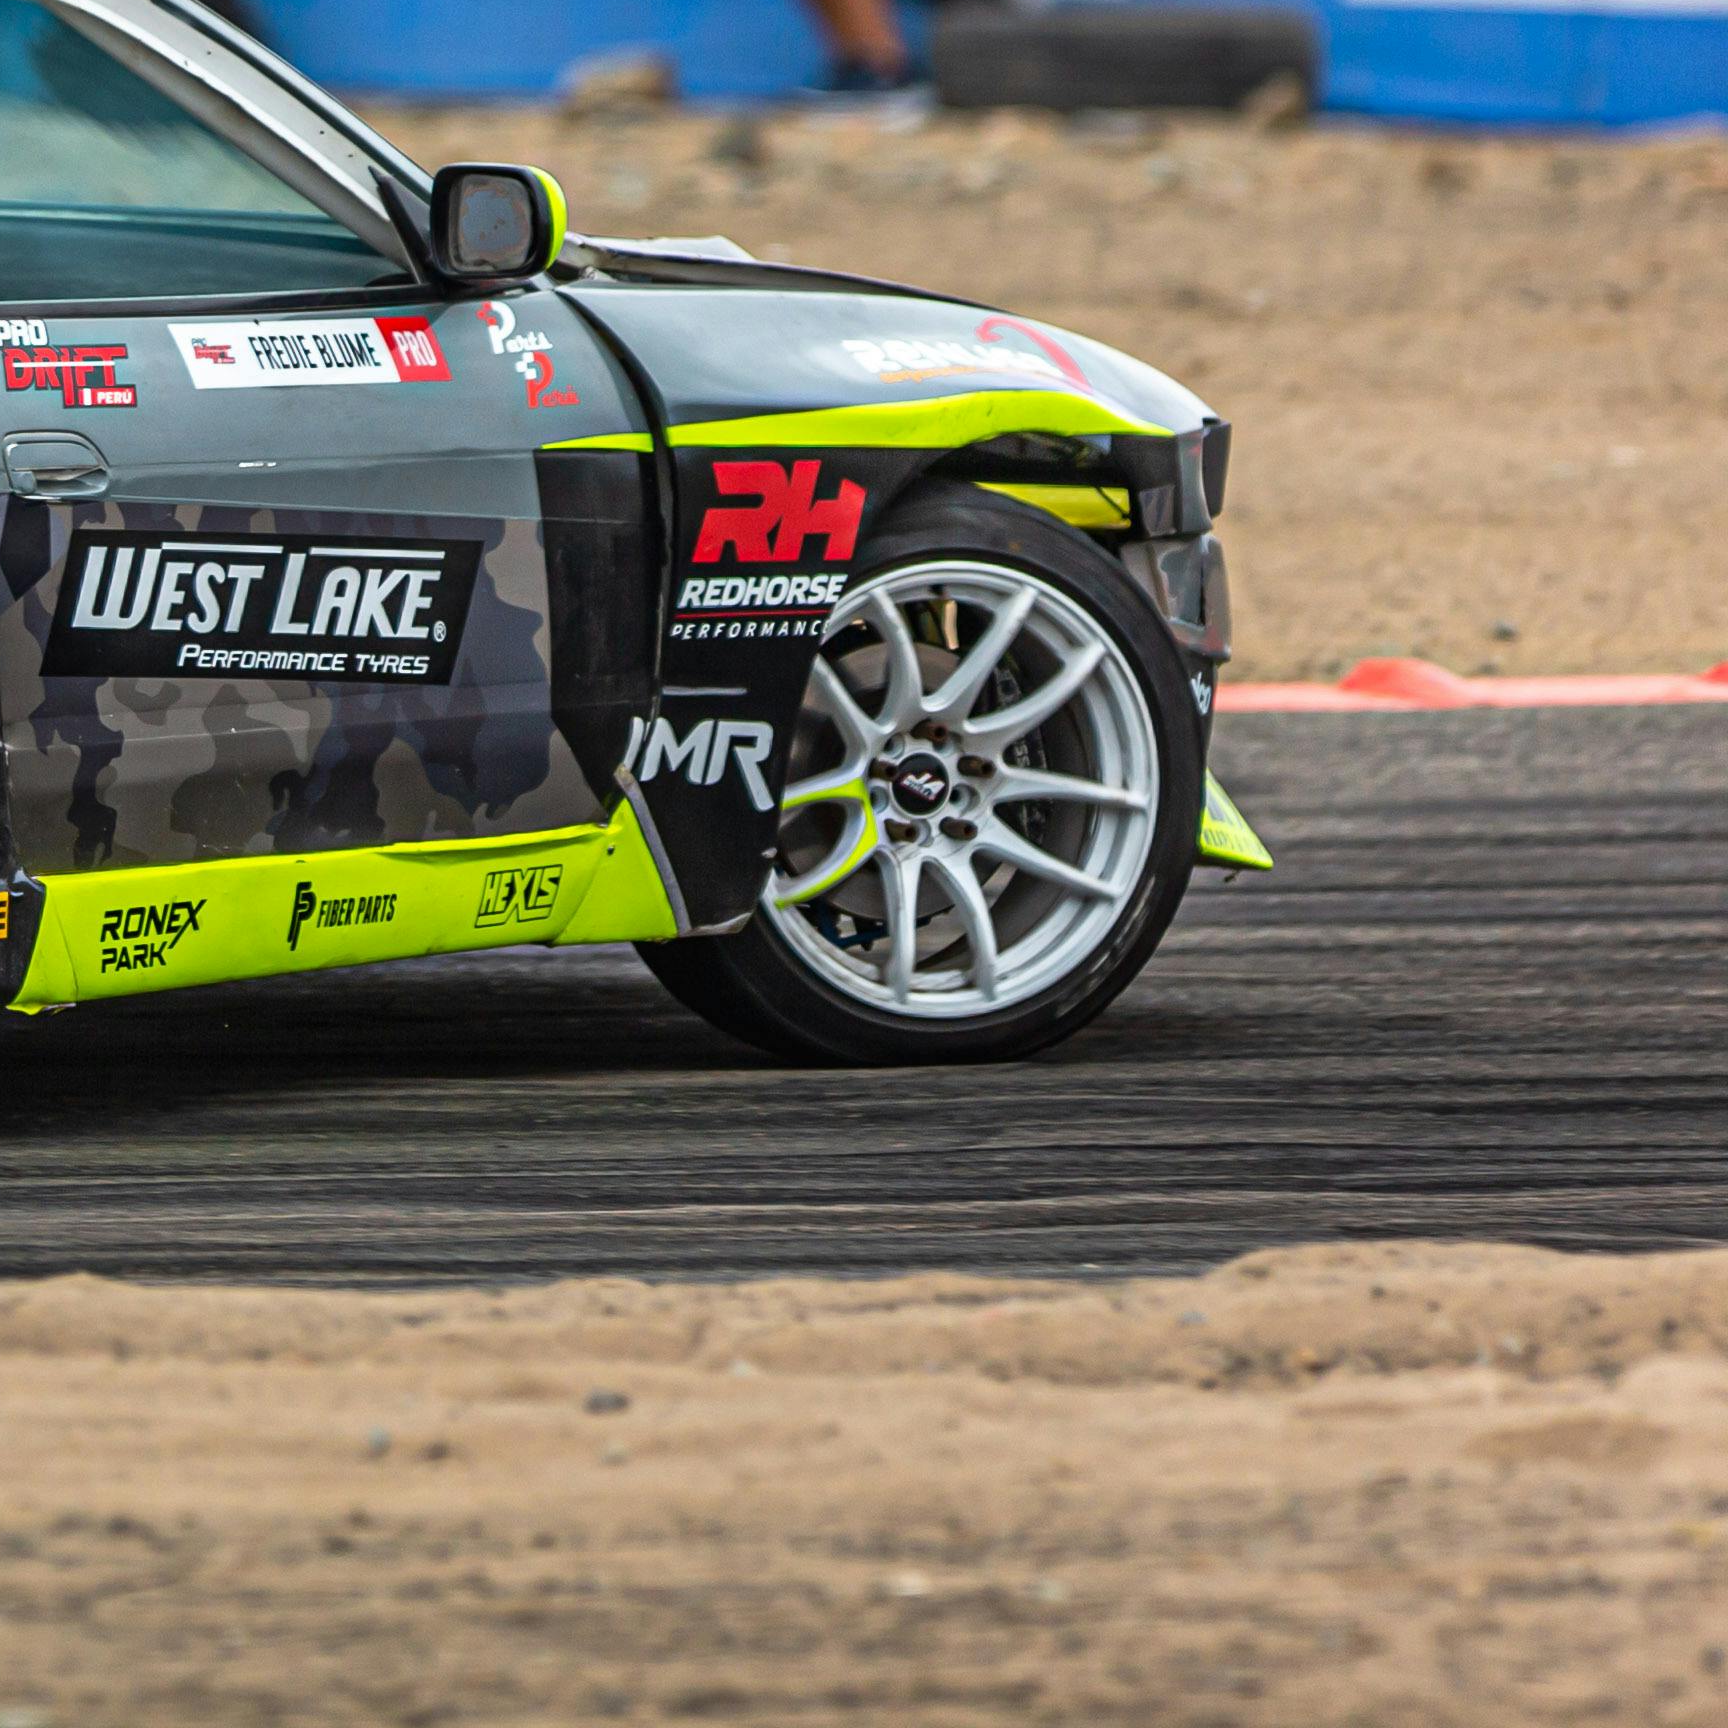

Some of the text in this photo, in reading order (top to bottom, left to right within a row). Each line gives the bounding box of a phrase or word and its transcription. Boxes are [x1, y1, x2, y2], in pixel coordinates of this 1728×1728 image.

[248, 334, 318, 370] FREDIE
[314, 333, 383, 368] BLUME
[392, 330, 438, 367] PRO
[5, 345, 128, 407] DRIFT
[72, 545, 266, 633] WEST
[677, 573, 849, 609] REDHORSE
[178, 643, 431, 675] PERFORMANCE TYRES
[317, 898, 356, 928] FIBER
[354, 893, 398, 925] PARTS
[474, 864, 564, 929] HEXIS
[100, 898, 207, 948] RONEX
[101, 944, 169, 973] PARK
